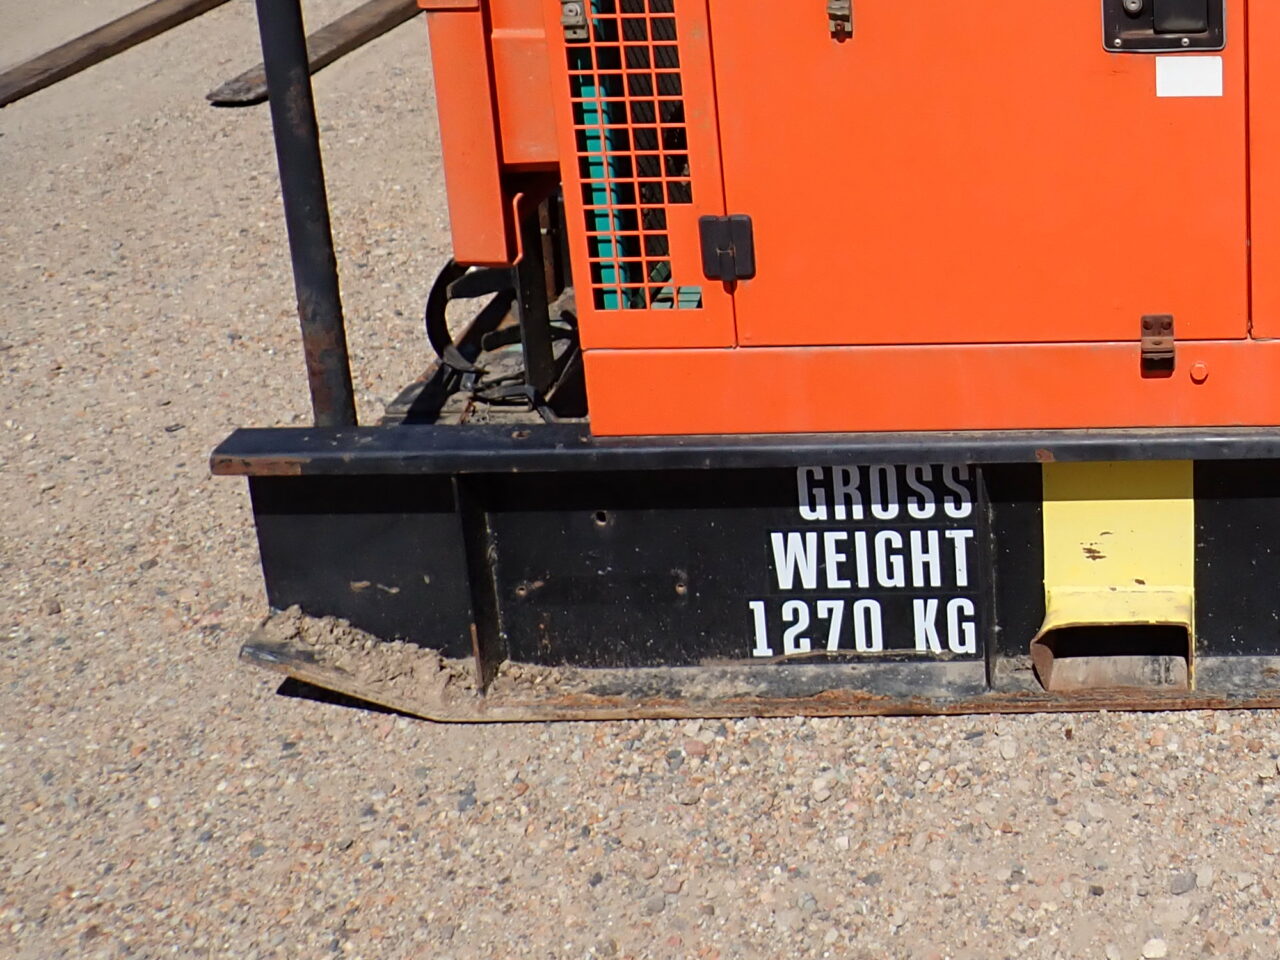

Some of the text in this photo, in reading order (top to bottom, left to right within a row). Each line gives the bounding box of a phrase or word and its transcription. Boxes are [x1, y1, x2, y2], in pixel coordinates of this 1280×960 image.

[796, 463, 973, 521] GROSS
[770, 529, 974, 590] WEIGHT
[749, 598, 977, 657] 1270 KG
